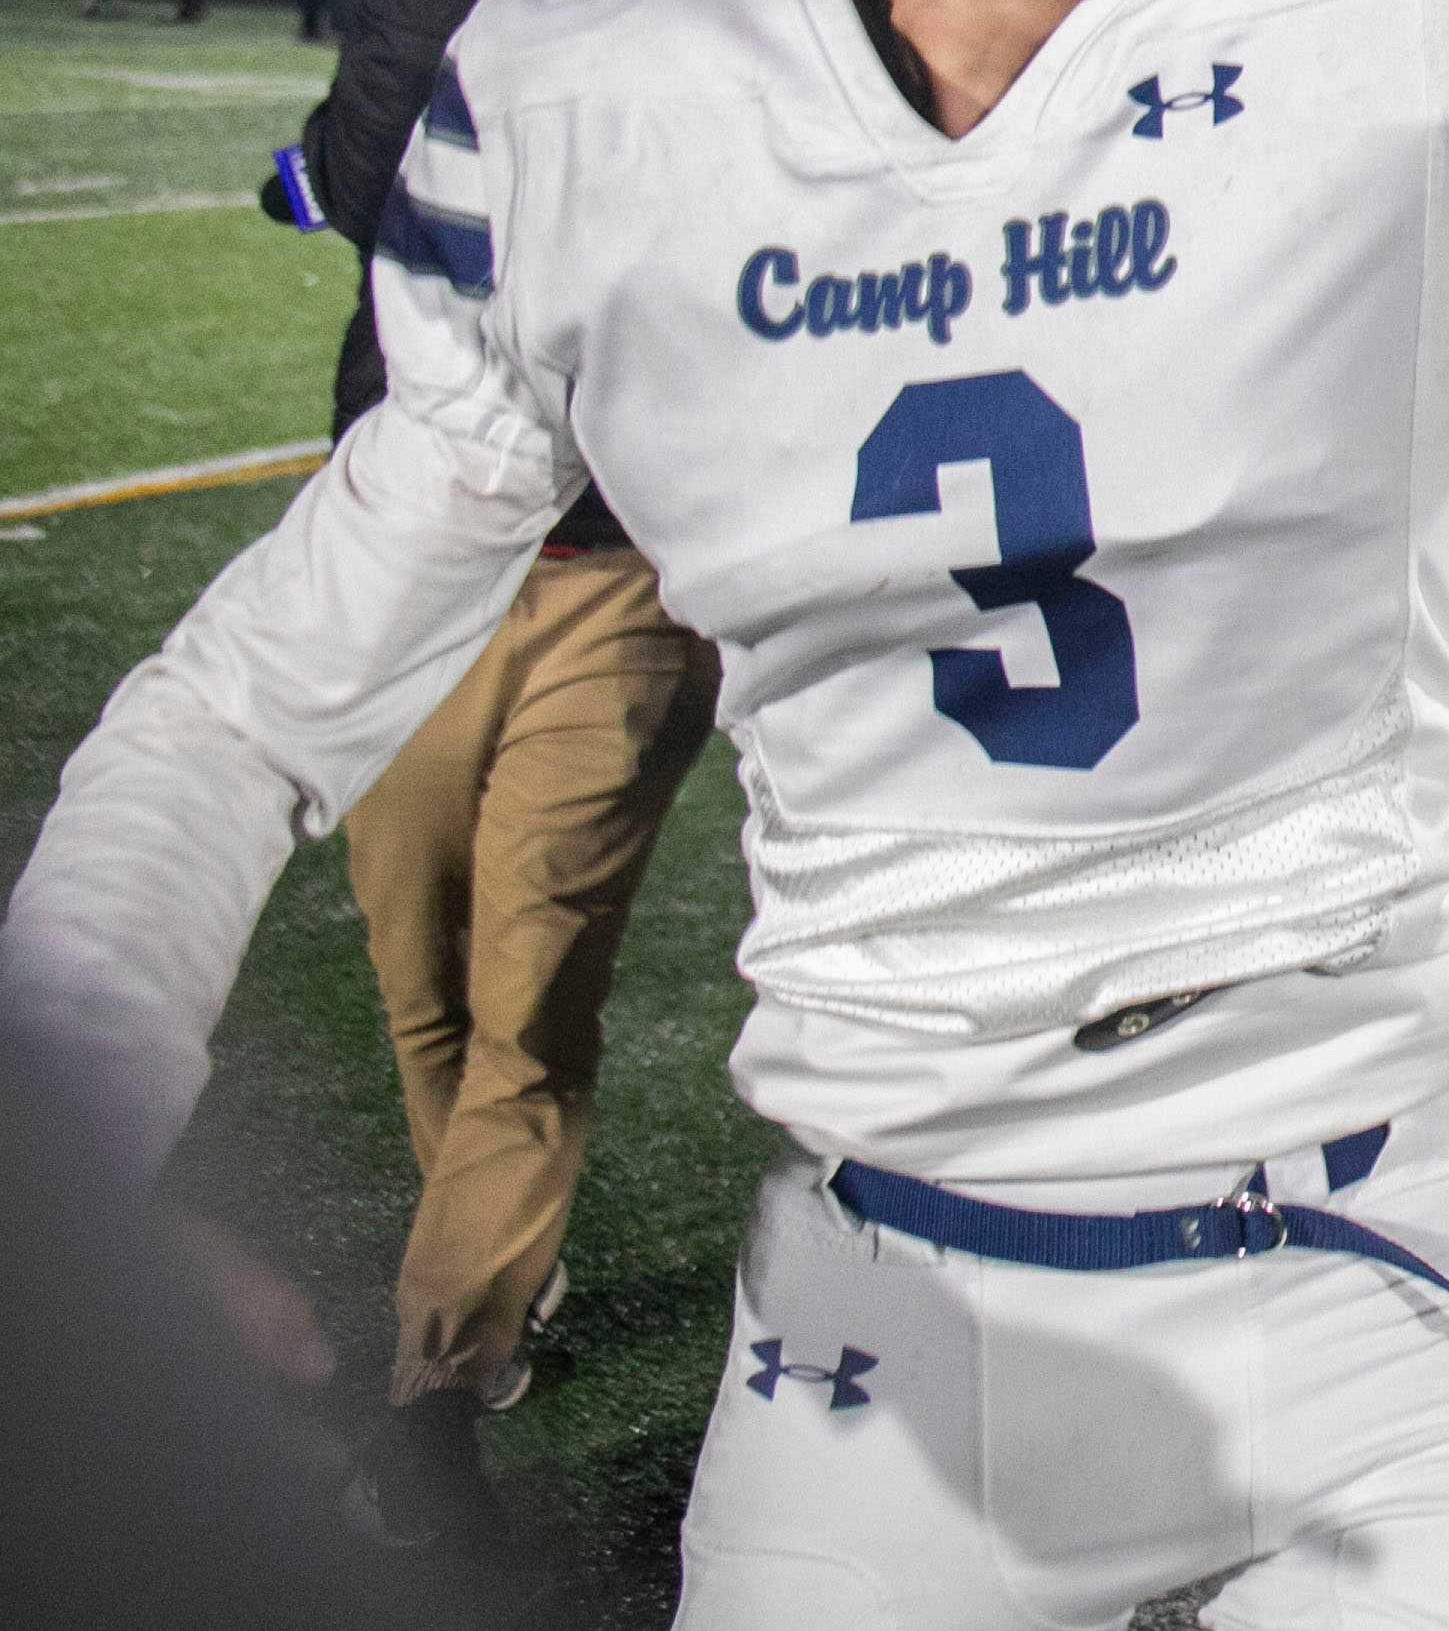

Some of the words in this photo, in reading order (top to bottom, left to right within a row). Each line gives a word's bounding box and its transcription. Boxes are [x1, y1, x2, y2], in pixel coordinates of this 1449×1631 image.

[737, 247, 972, 344] Camp
[1002, 199, 1177, 315] Hill
[850, 369, 1140, 770] 3
